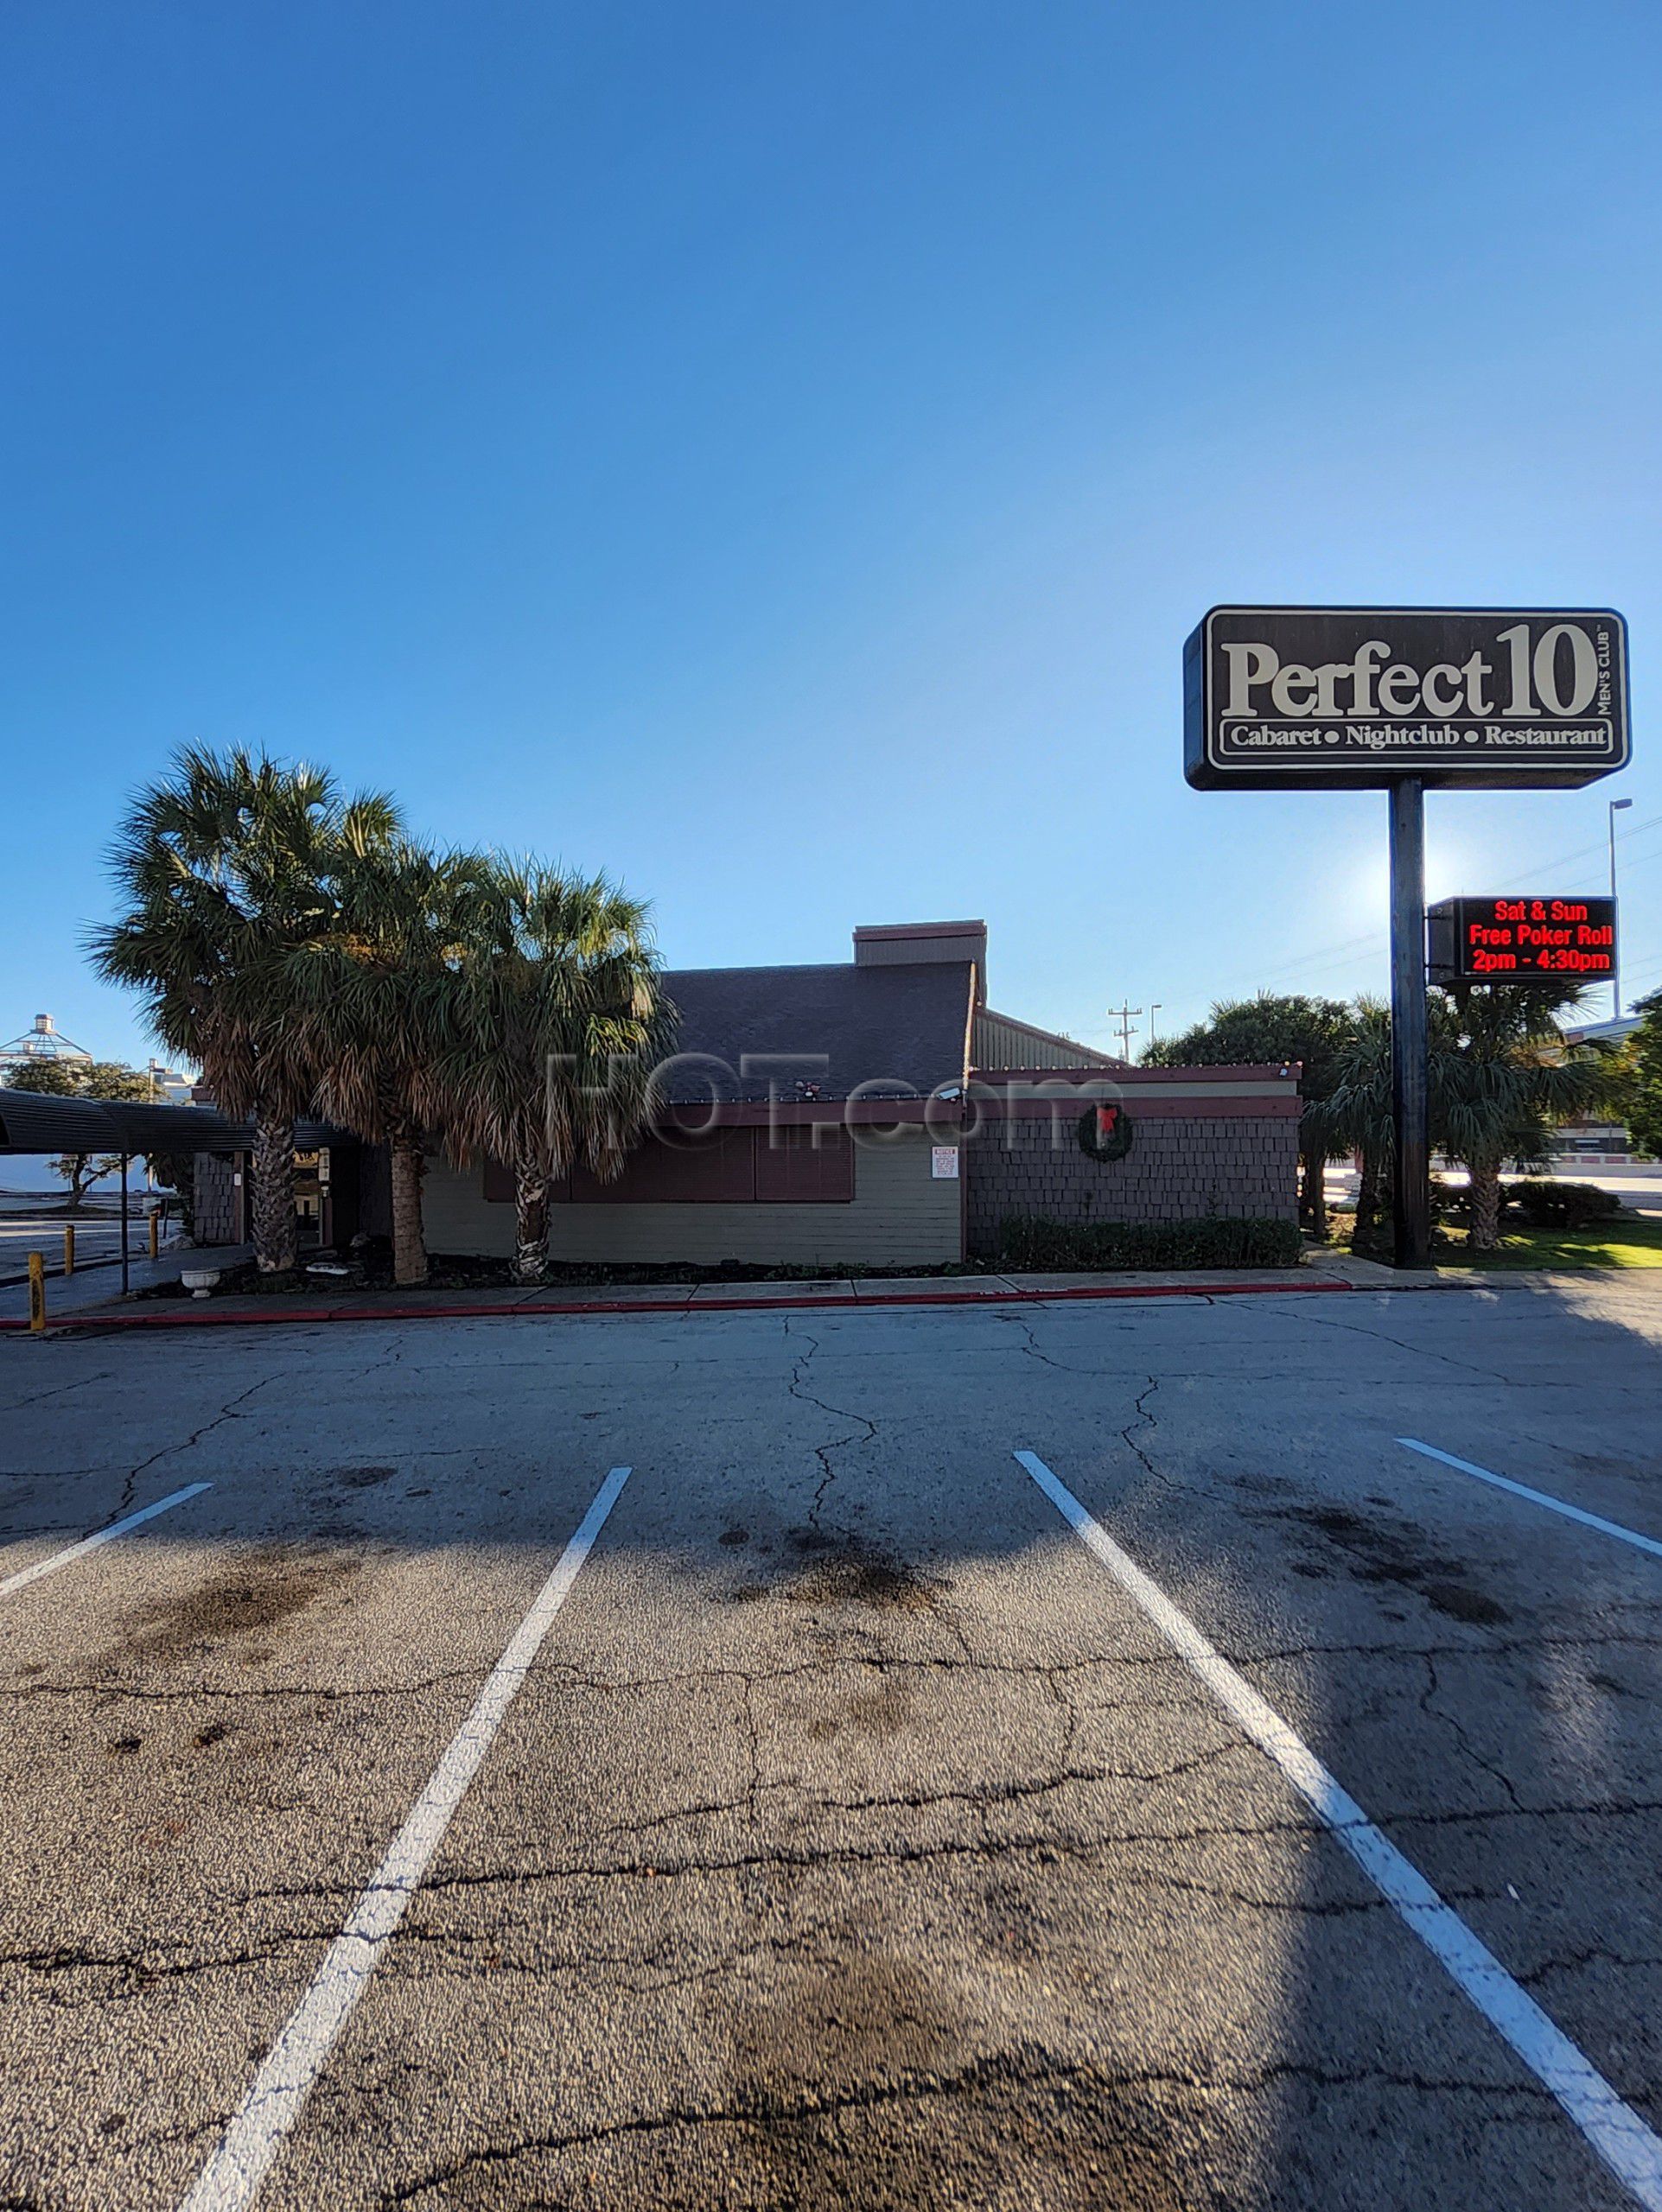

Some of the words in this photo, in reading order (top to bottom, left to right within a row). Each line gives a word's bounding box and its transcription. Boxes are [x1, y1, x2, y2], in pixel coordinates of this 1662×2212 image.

[1220, 640, 1494, 716] Perfect
[1496, 624, 1598, 716] 10
[1596, 671, 1613, 715] MEN'S
[1231, 725, 1322, 746] Cabaret
[1345, 725, 1461, 749] Nightclub
[1484, 725, 1608, 746] Restaurant
[1494, 900, 1526, 921] Sat
[1530, 900, 1547, 921] &
[1551, 900, 1588, 921] Sun
[1469, 924, 1512, 945] Free
[1517, 924, 1572, 945] Poker
[1577, 925, 1613, 945] Roll
[1473, 949, 1517, 972] 2pm
[1536, 949, 1610, 972] 4:30pm
